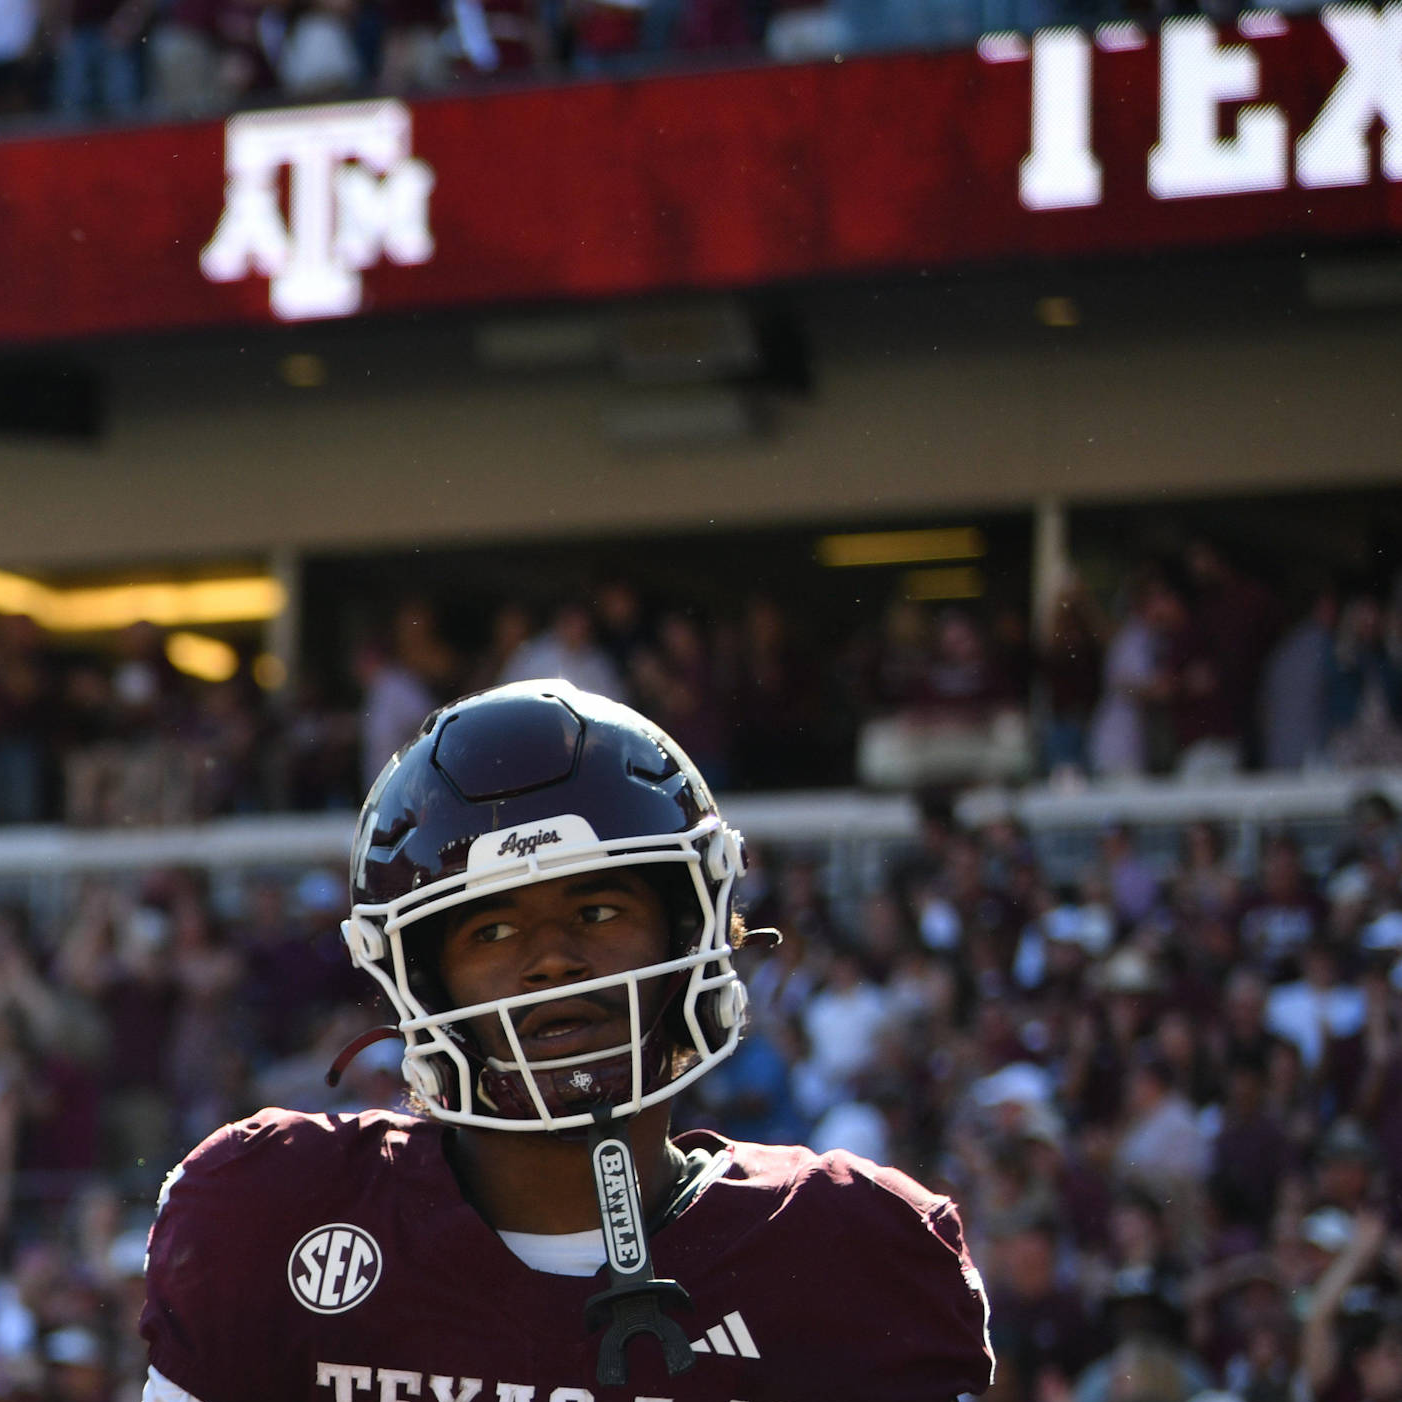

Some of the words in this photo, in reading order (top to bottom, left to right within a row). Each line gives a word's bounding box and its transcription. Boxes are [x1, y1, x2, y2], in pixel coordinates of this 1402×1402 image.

[497, 829, 562, 858] Aggies
[600, 1151, 640, 1263] BATTLE
[295, 1229, 375, 1307] SEC
